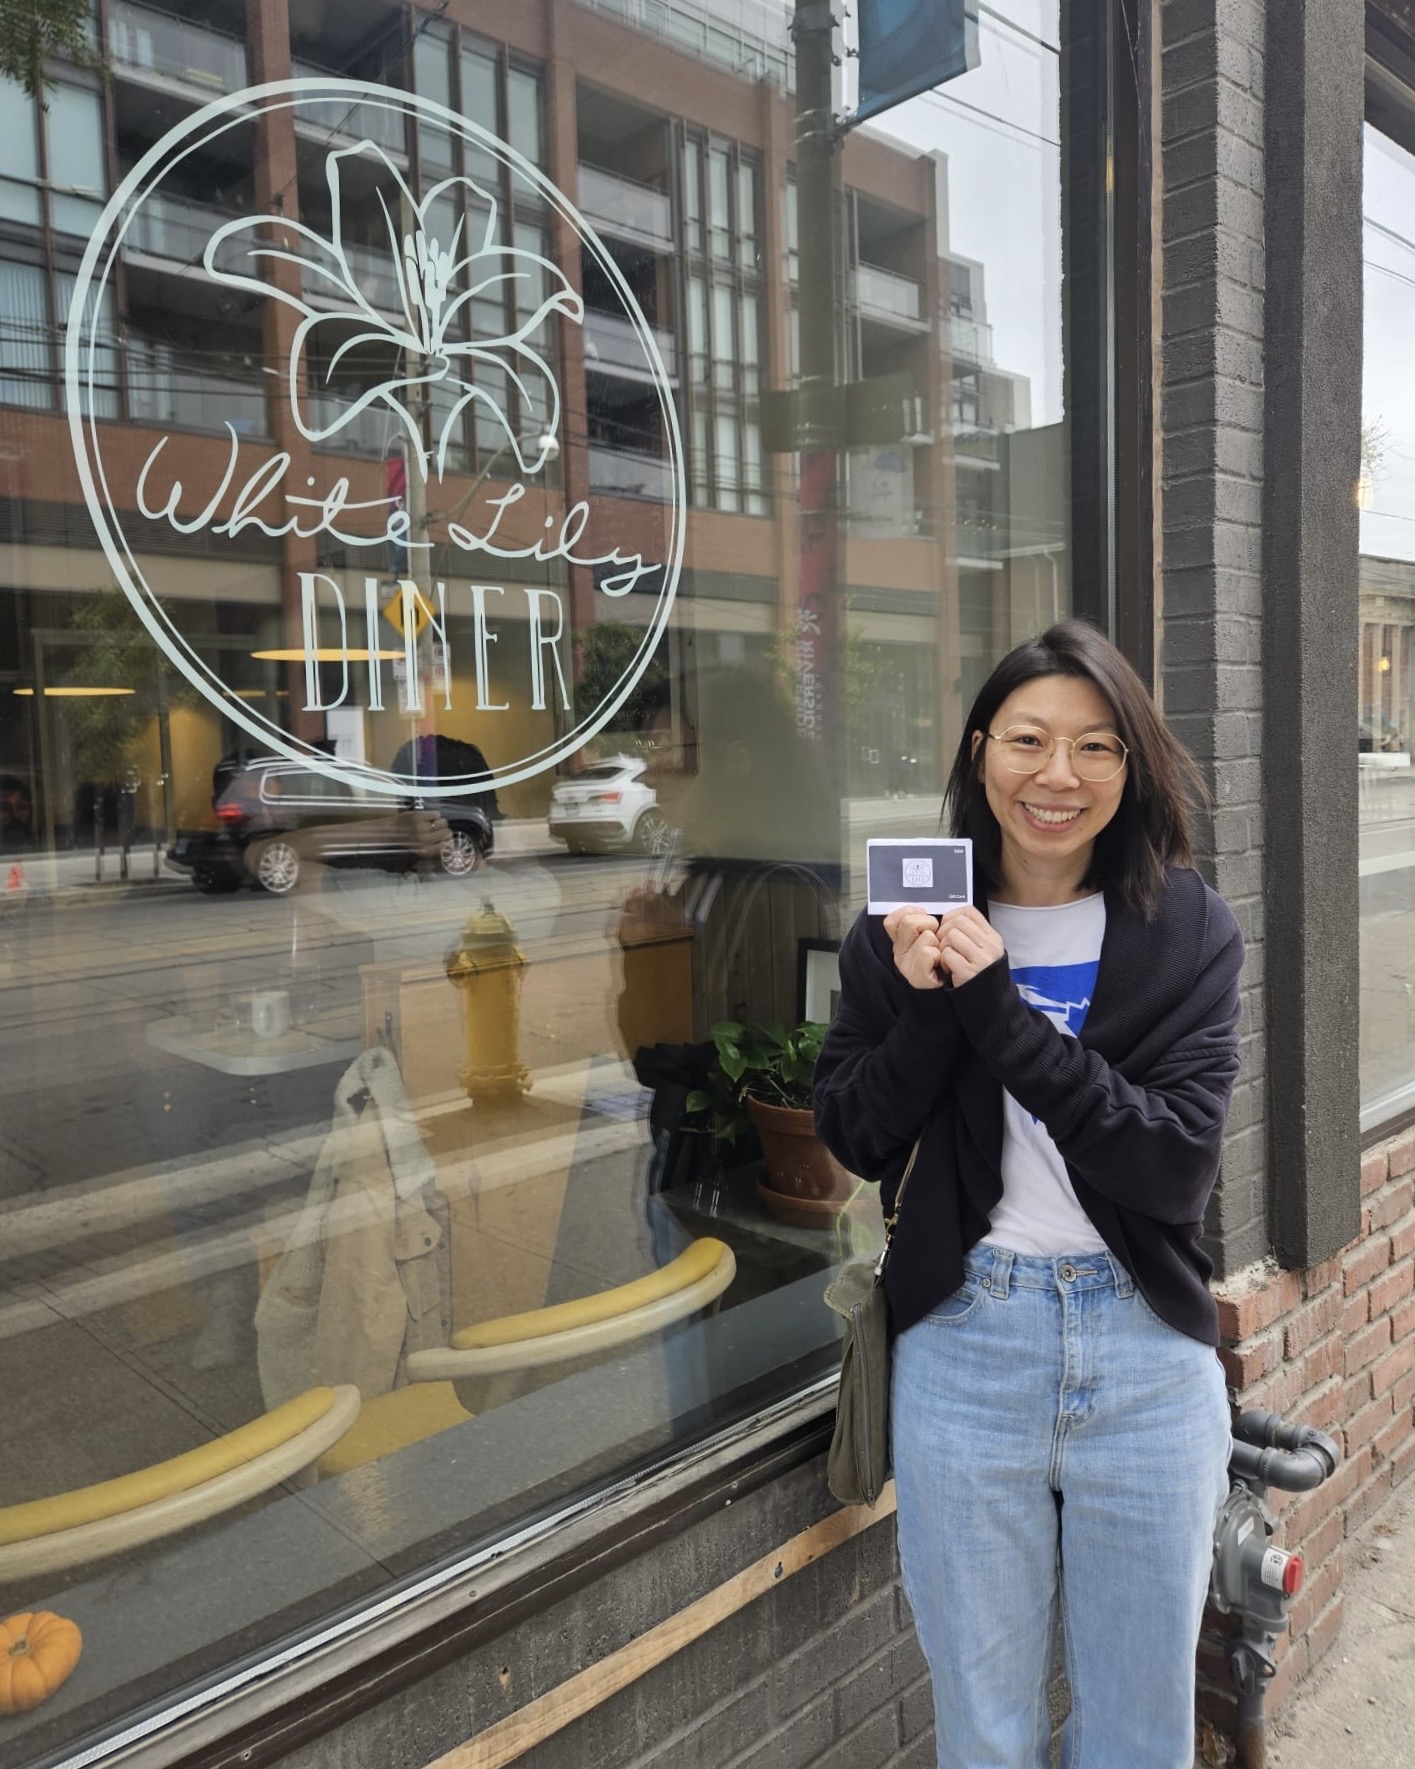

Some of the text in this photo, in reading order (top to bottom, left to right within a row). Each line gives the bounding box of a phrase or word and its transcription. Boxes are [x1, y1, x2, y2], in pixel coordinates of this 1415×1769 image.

[136, 421, 662, 597] White Lily
[297, 572, 572, 712] DINER
